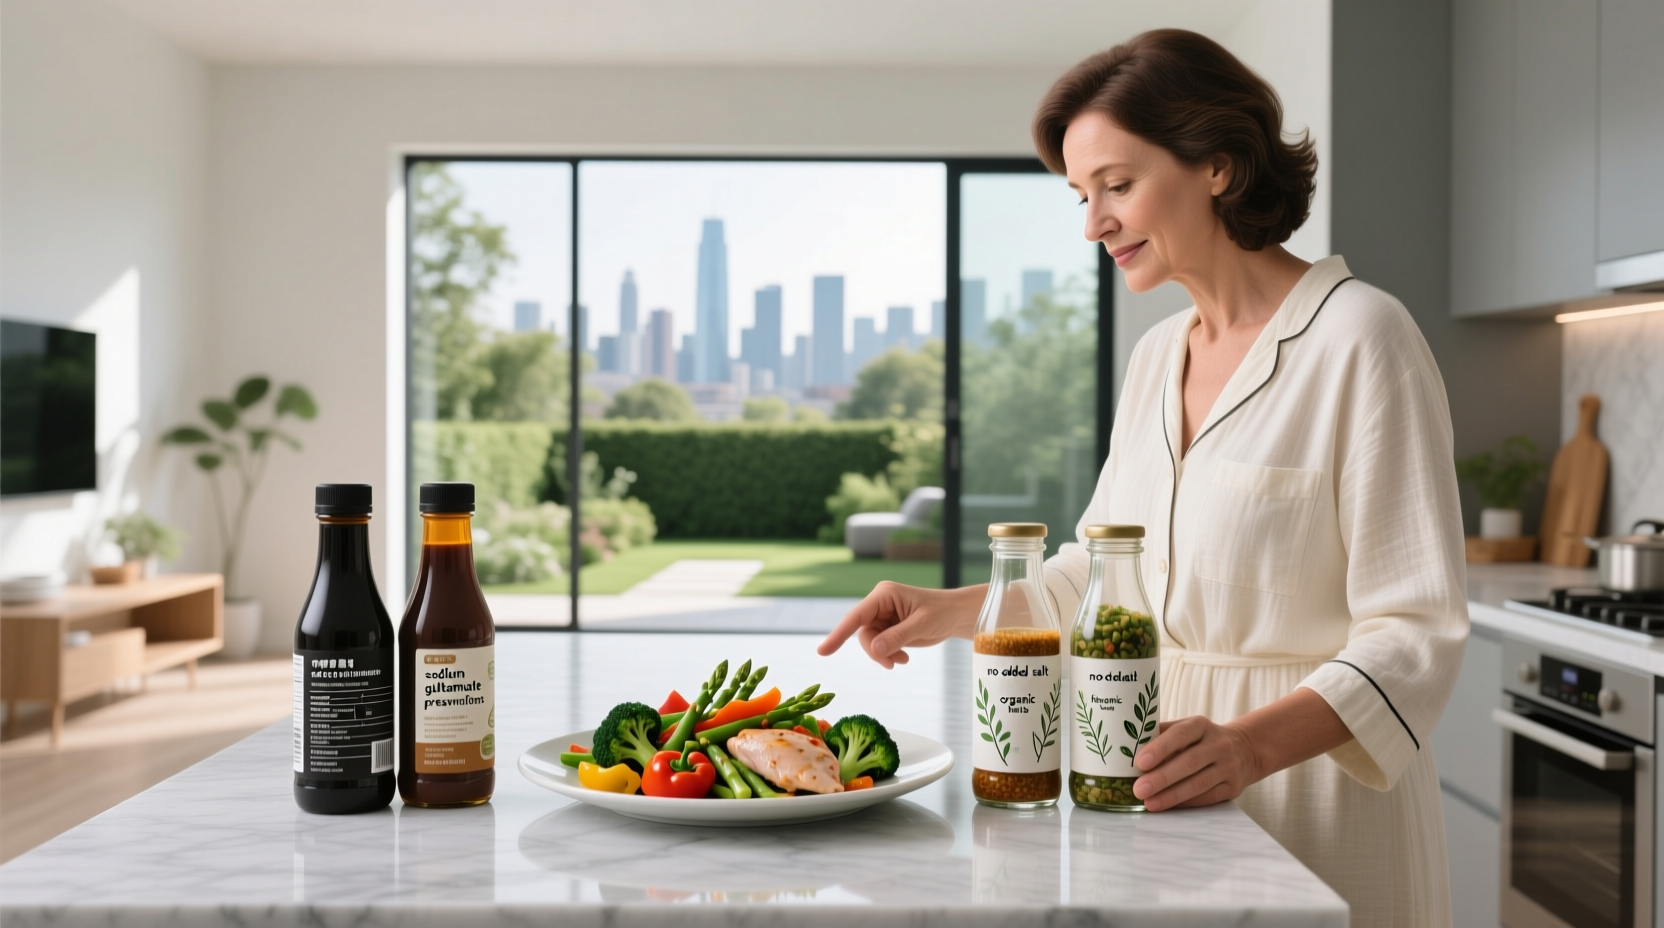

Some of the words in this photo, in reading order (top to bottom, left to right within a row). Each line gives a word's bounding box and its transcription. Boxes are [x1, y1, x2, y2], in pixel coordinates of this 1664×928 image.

[987, 668, 999, 676] no
[1032, 665, 1049, 677] salt
[1000, 693, 1036, 706] organic
